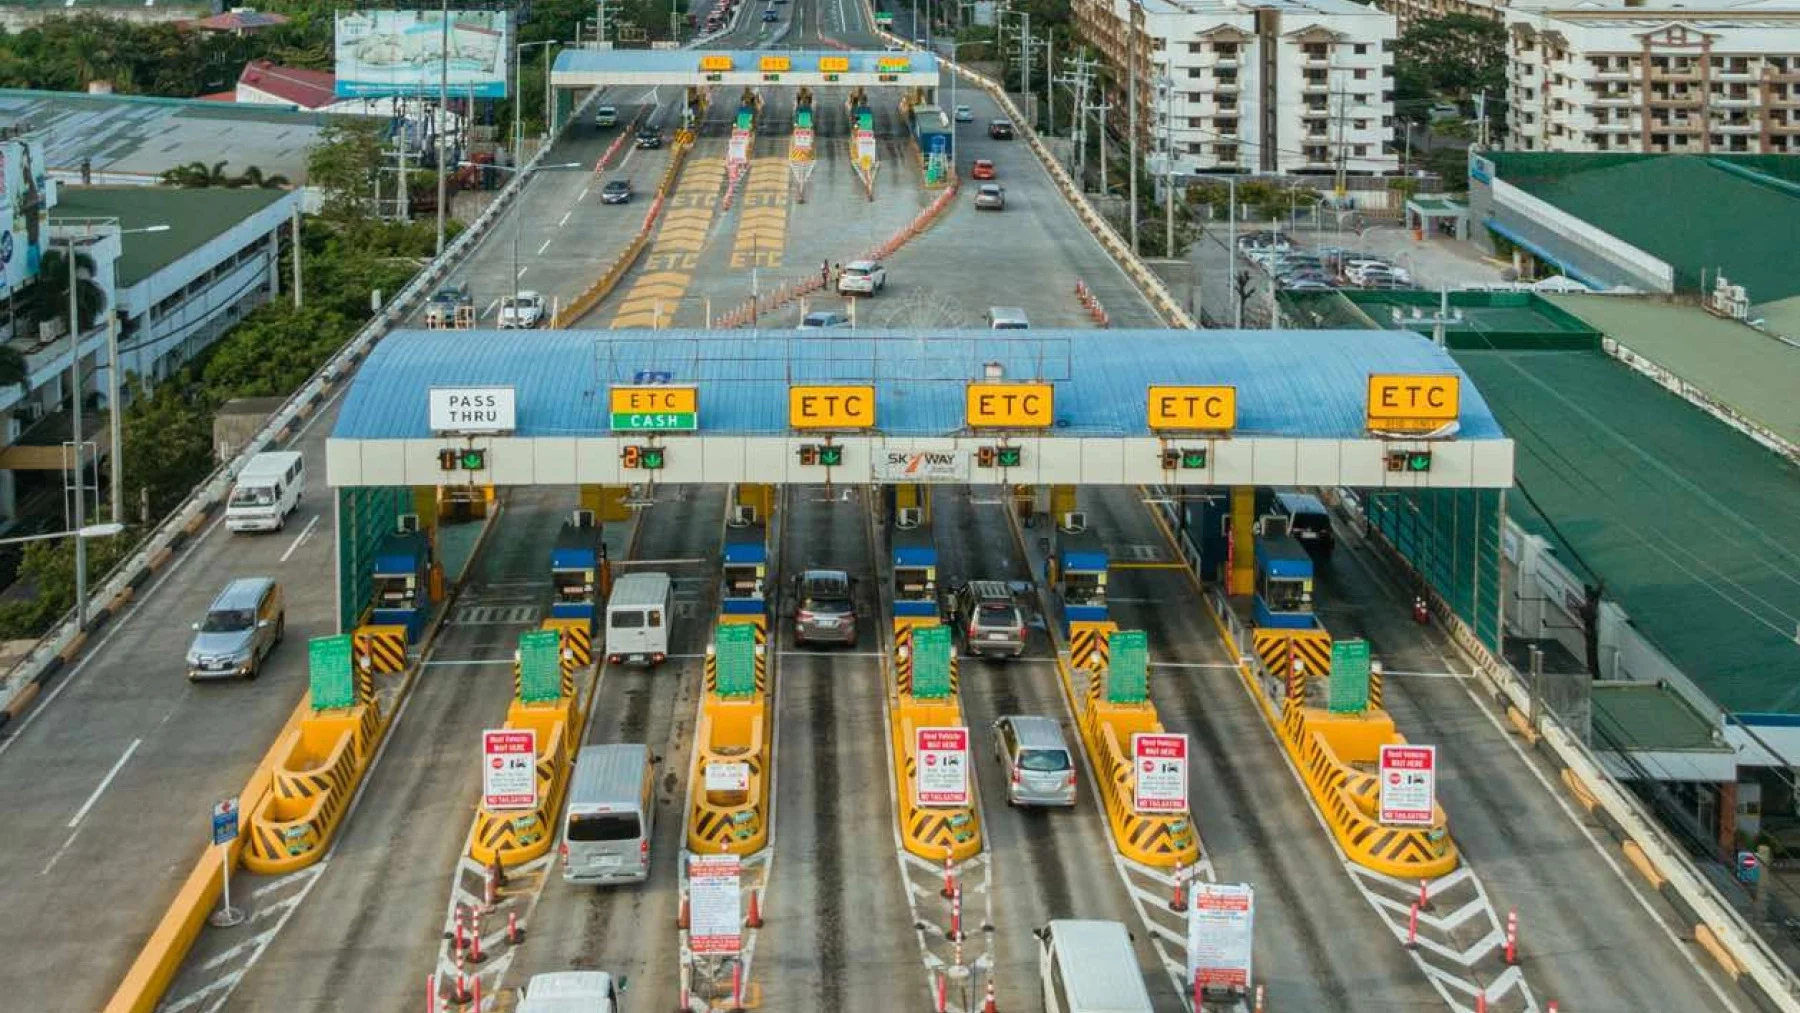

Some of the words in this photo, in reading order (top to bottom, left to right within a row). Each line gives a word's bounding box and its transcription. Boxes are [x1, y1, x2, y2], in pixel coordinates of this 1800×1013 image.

[644, 253, 700, 270] ETC
[730, 252, 783, 268] ETC
[449, 395, 495, 407] PASS
[630, 393, 676, 408] ETC
[980, 394, 1040, 416] ETC
[1382, 385, 1444, 408] ETC
[802, 395, 862, 417] ETC
[1161, 396, 1223, 418] ETC
[449, 411, 497, 422] THRU
[630, 415, 677, 427] CASH
[625, 446, 637, 467] 2
